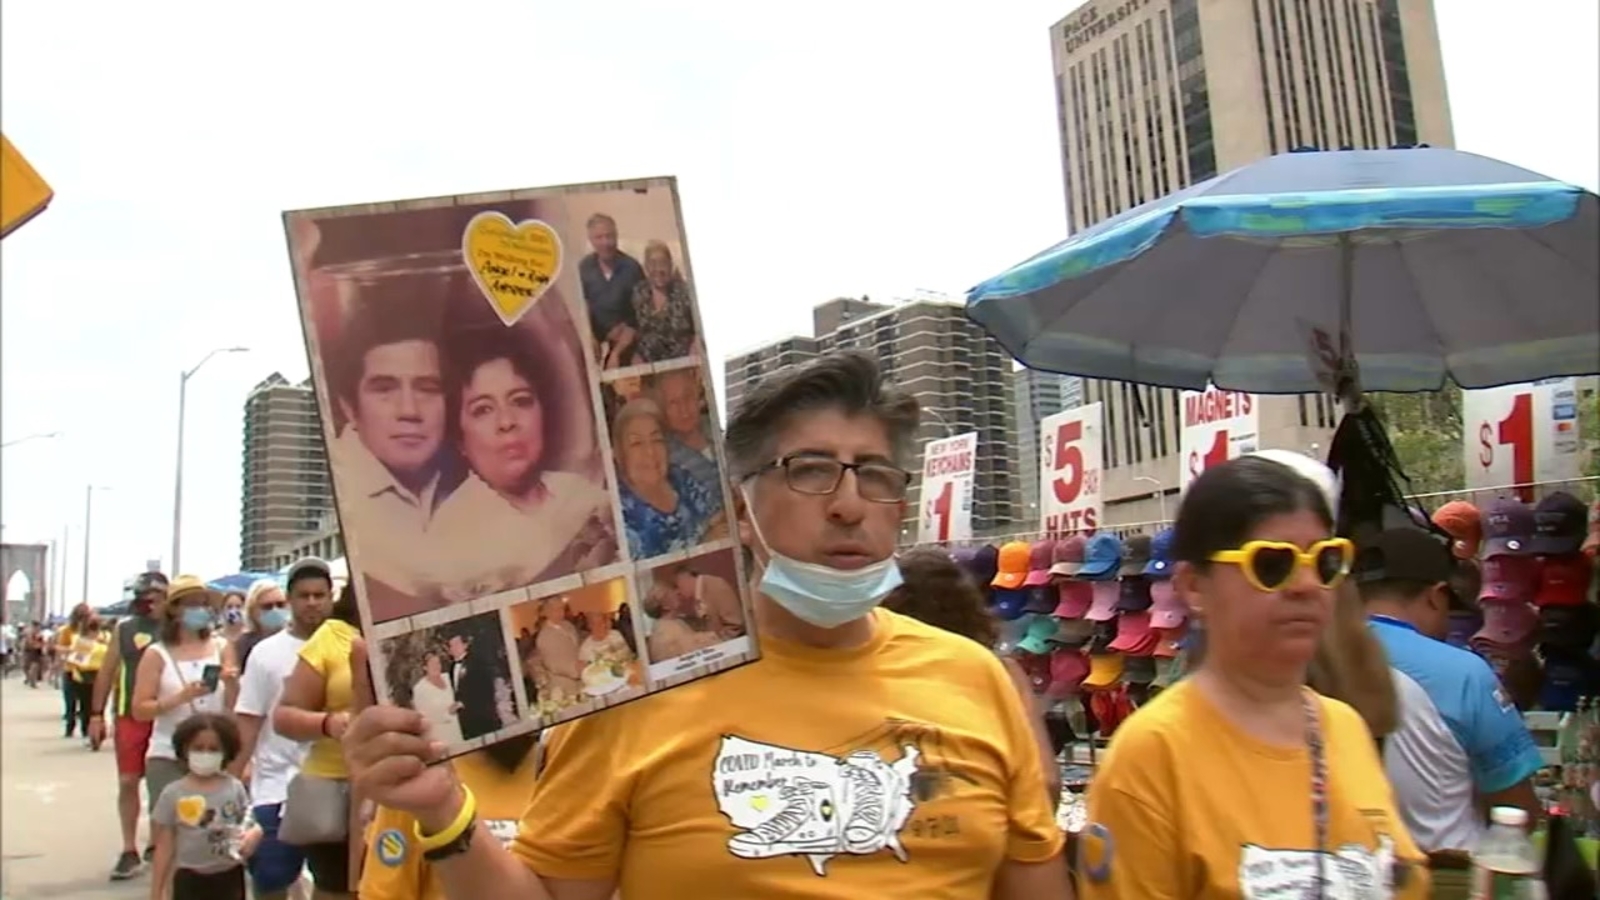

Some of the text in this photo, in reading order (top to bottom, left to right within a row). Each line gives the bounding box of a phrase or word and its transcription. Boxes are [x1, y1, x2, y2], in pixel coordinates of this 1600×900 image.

[1063, 6, 1098, 38] PACE
[1185, 390, 1252, 428] MAGNETS
[1046, 507, 1097, 540] HATS
[762, 751, 802, 771] March
[804, 754, 817, 768] to
[723, 771, 788, 798] Remember
